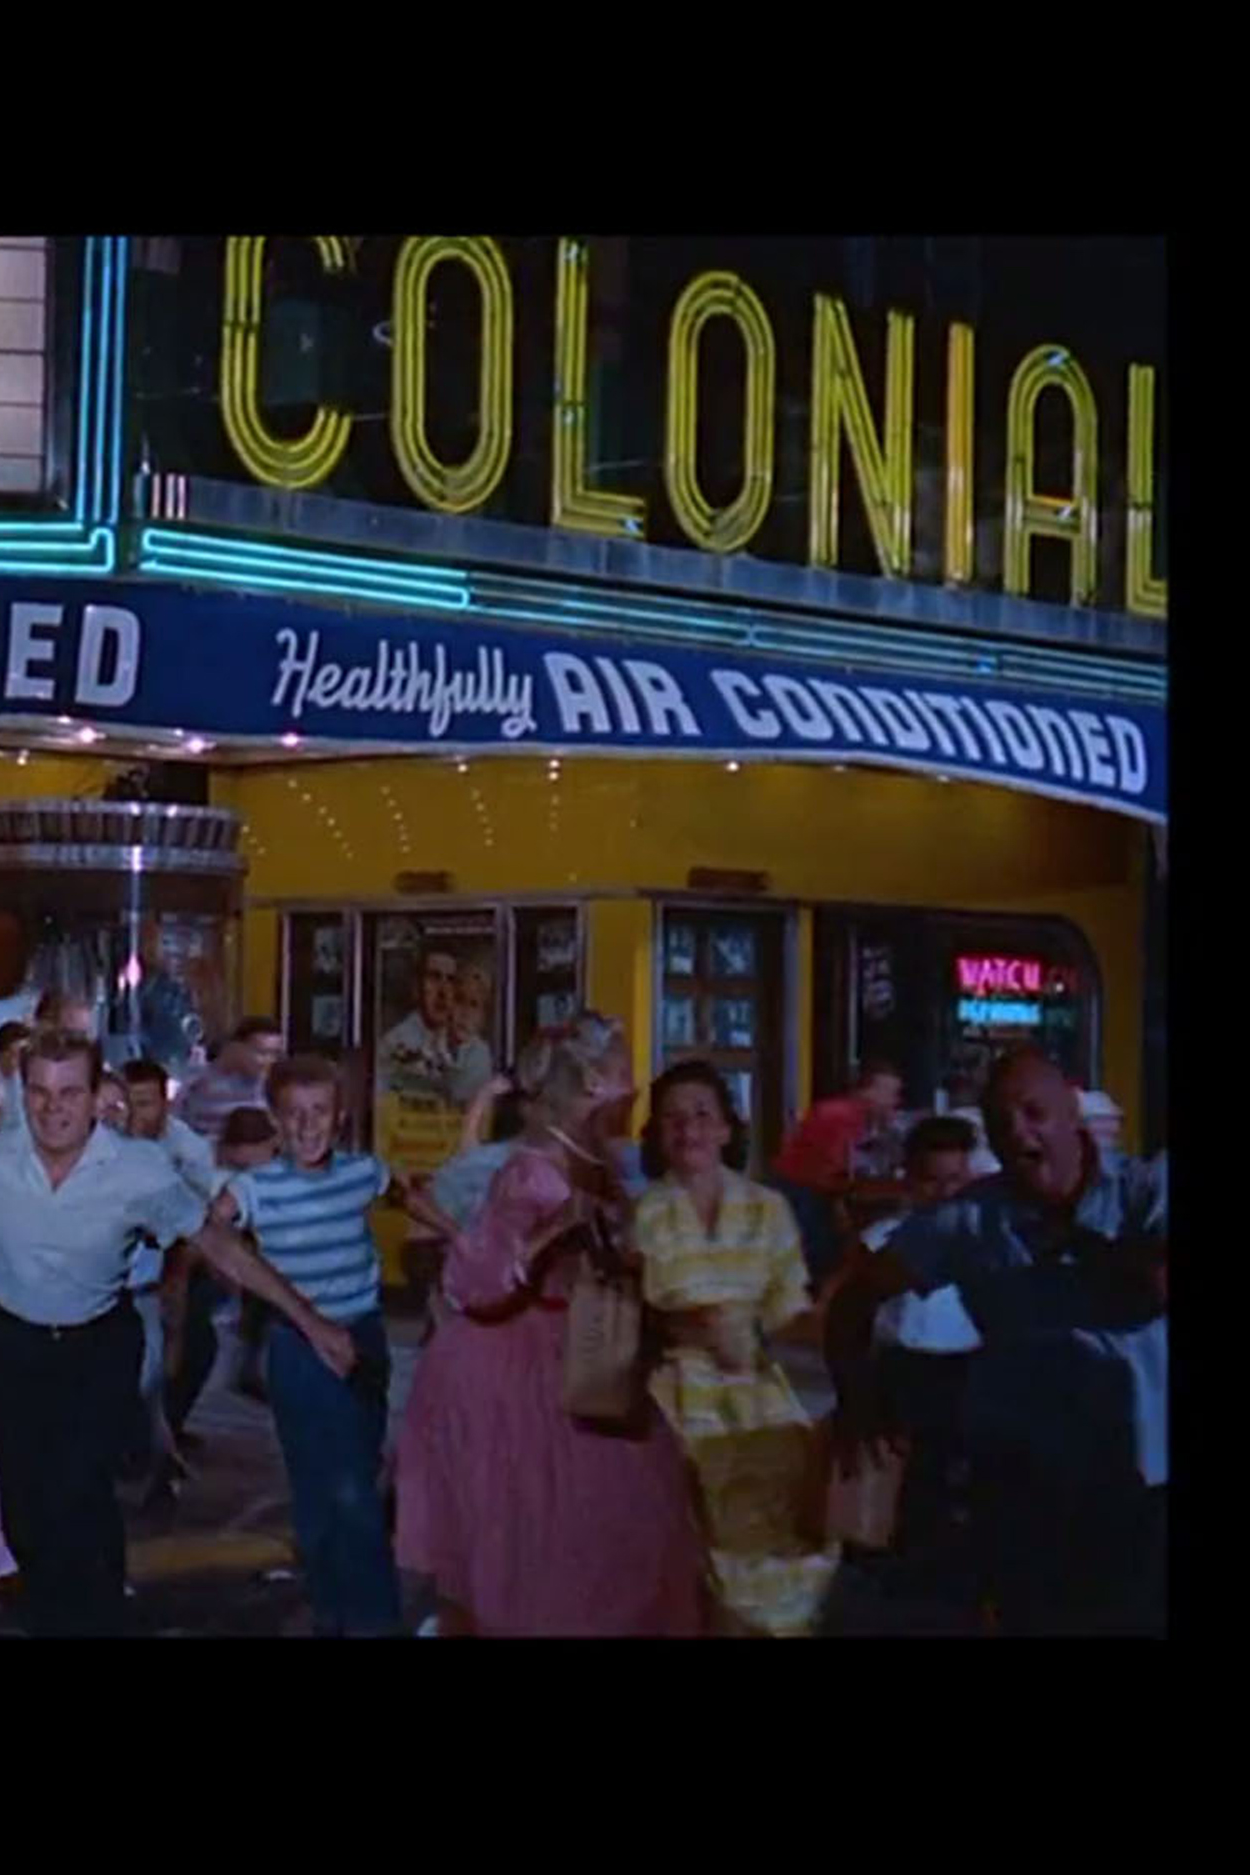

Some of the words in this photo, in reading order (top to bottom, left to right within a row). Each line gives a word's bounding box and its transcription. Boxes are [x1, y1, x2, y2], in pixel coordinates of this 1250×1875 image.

[220, 236, 1167, 618] COLONIAL
[271, 627, 538, 738] Healthfully
[546, 652, 702, 738] AIR
[710, 667, 1149, 796] CONDITIONED
